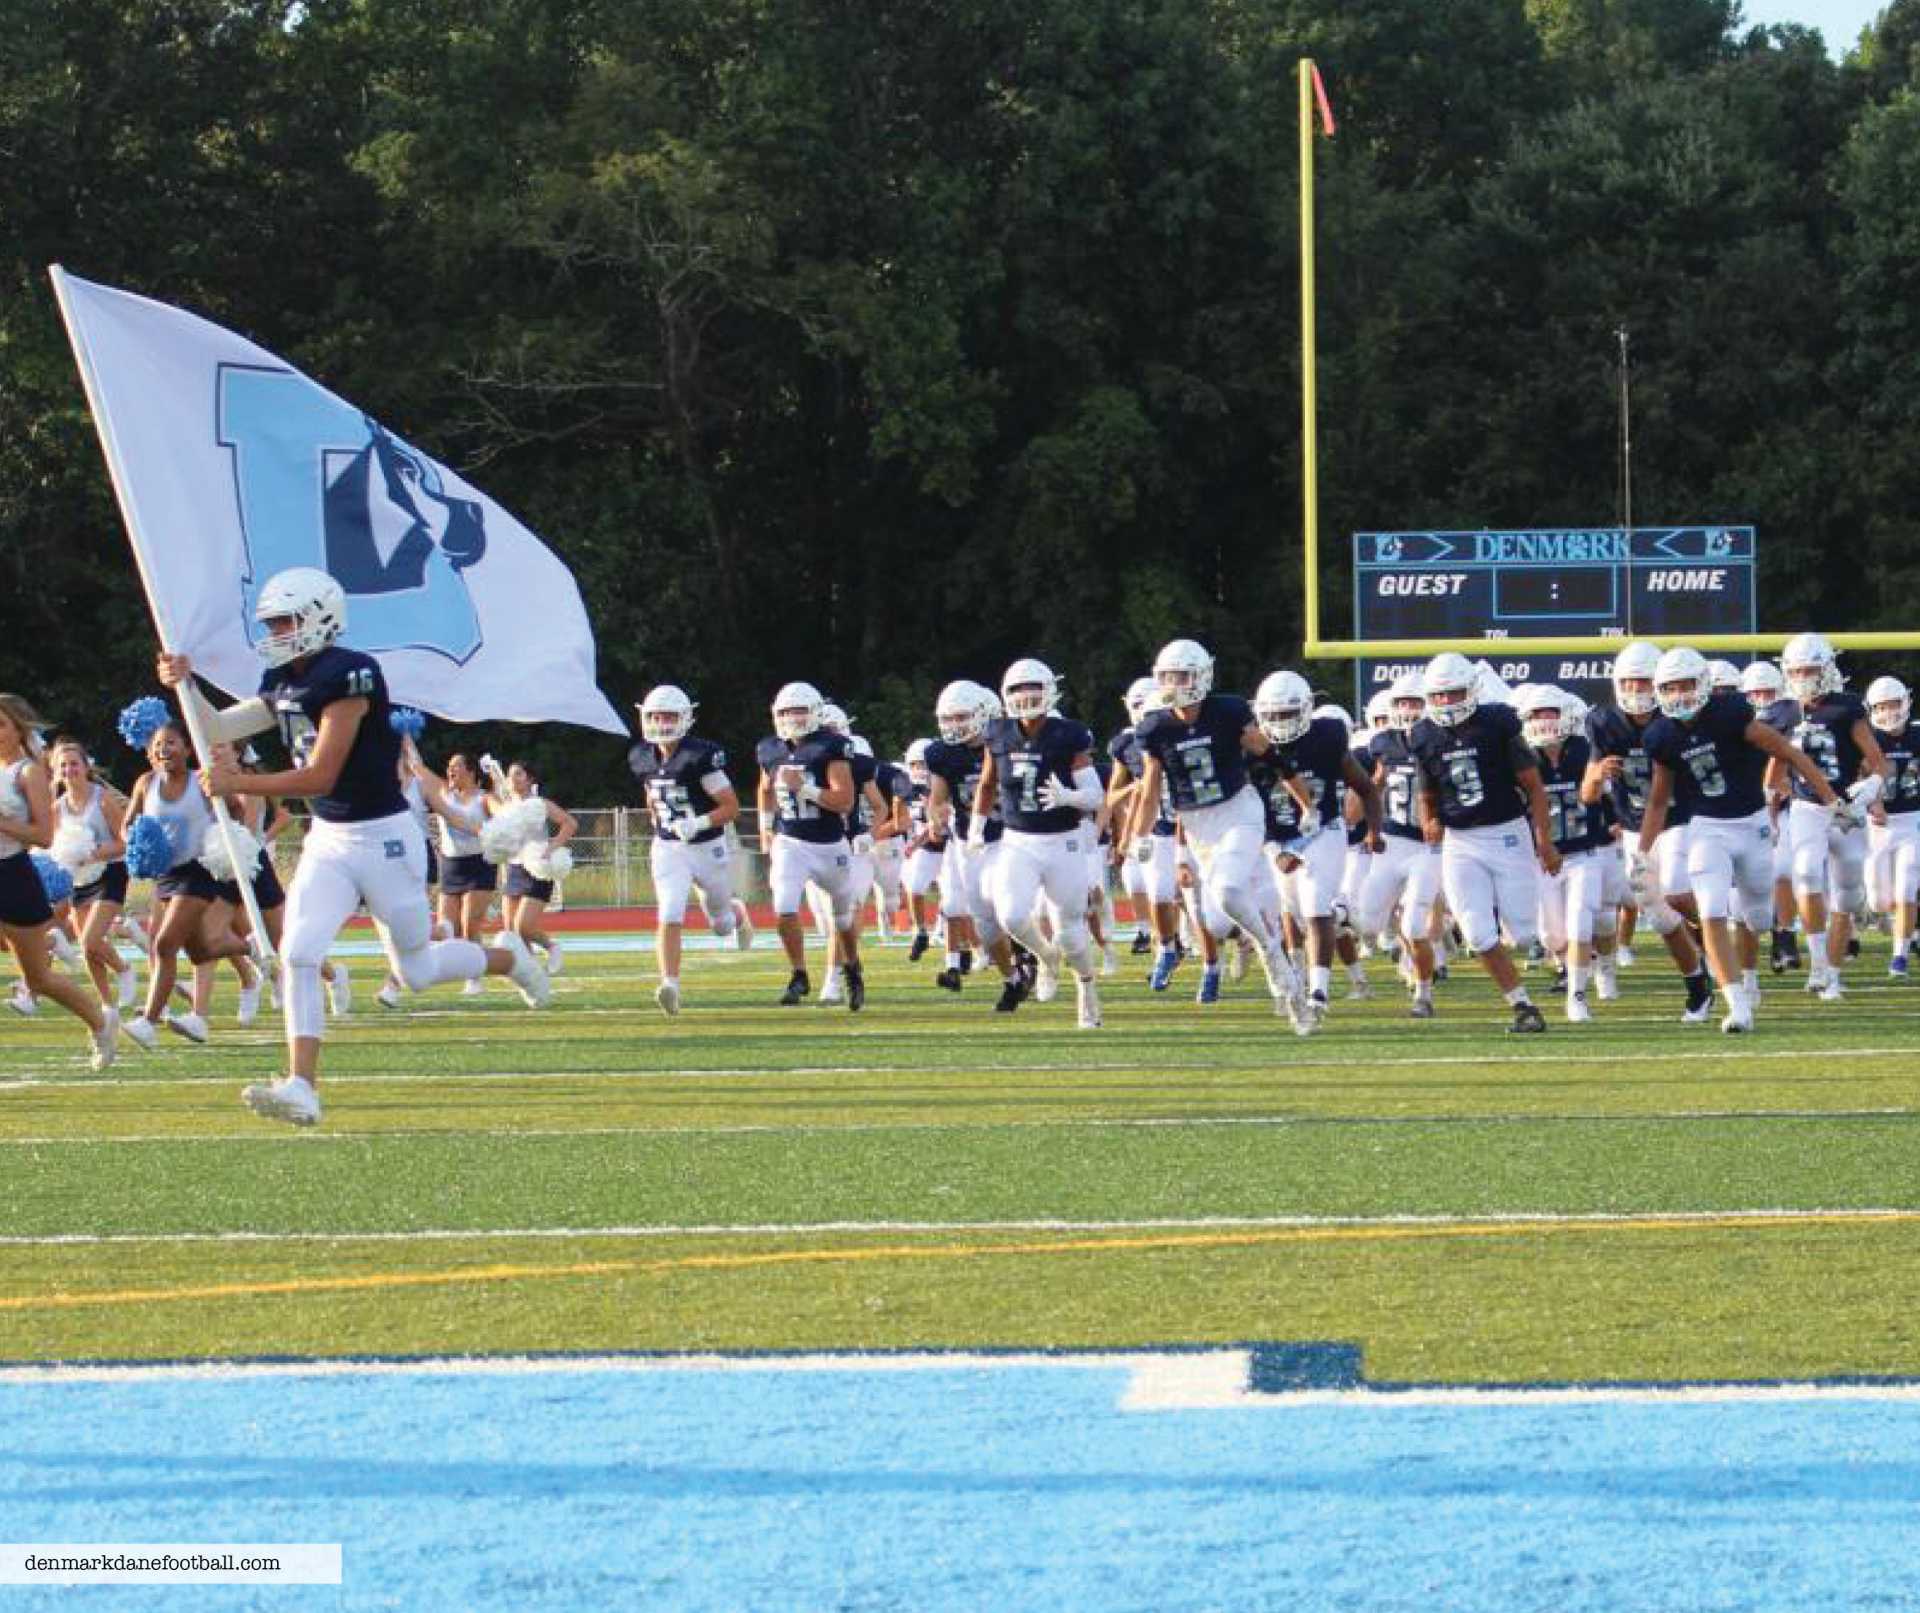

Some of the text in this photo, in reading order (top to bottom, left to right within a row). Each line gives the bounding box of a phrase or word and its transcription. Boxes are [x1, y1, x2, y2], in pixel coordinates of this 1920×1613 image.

[1378, 574, 1468, 596] GUEST
[1647, 569, 1728, 591] HOME
[1502, 663, 1530, 680] GO
[1012, 762, 1039, 812] 7
[1183, 748, 1223, 804] 2
